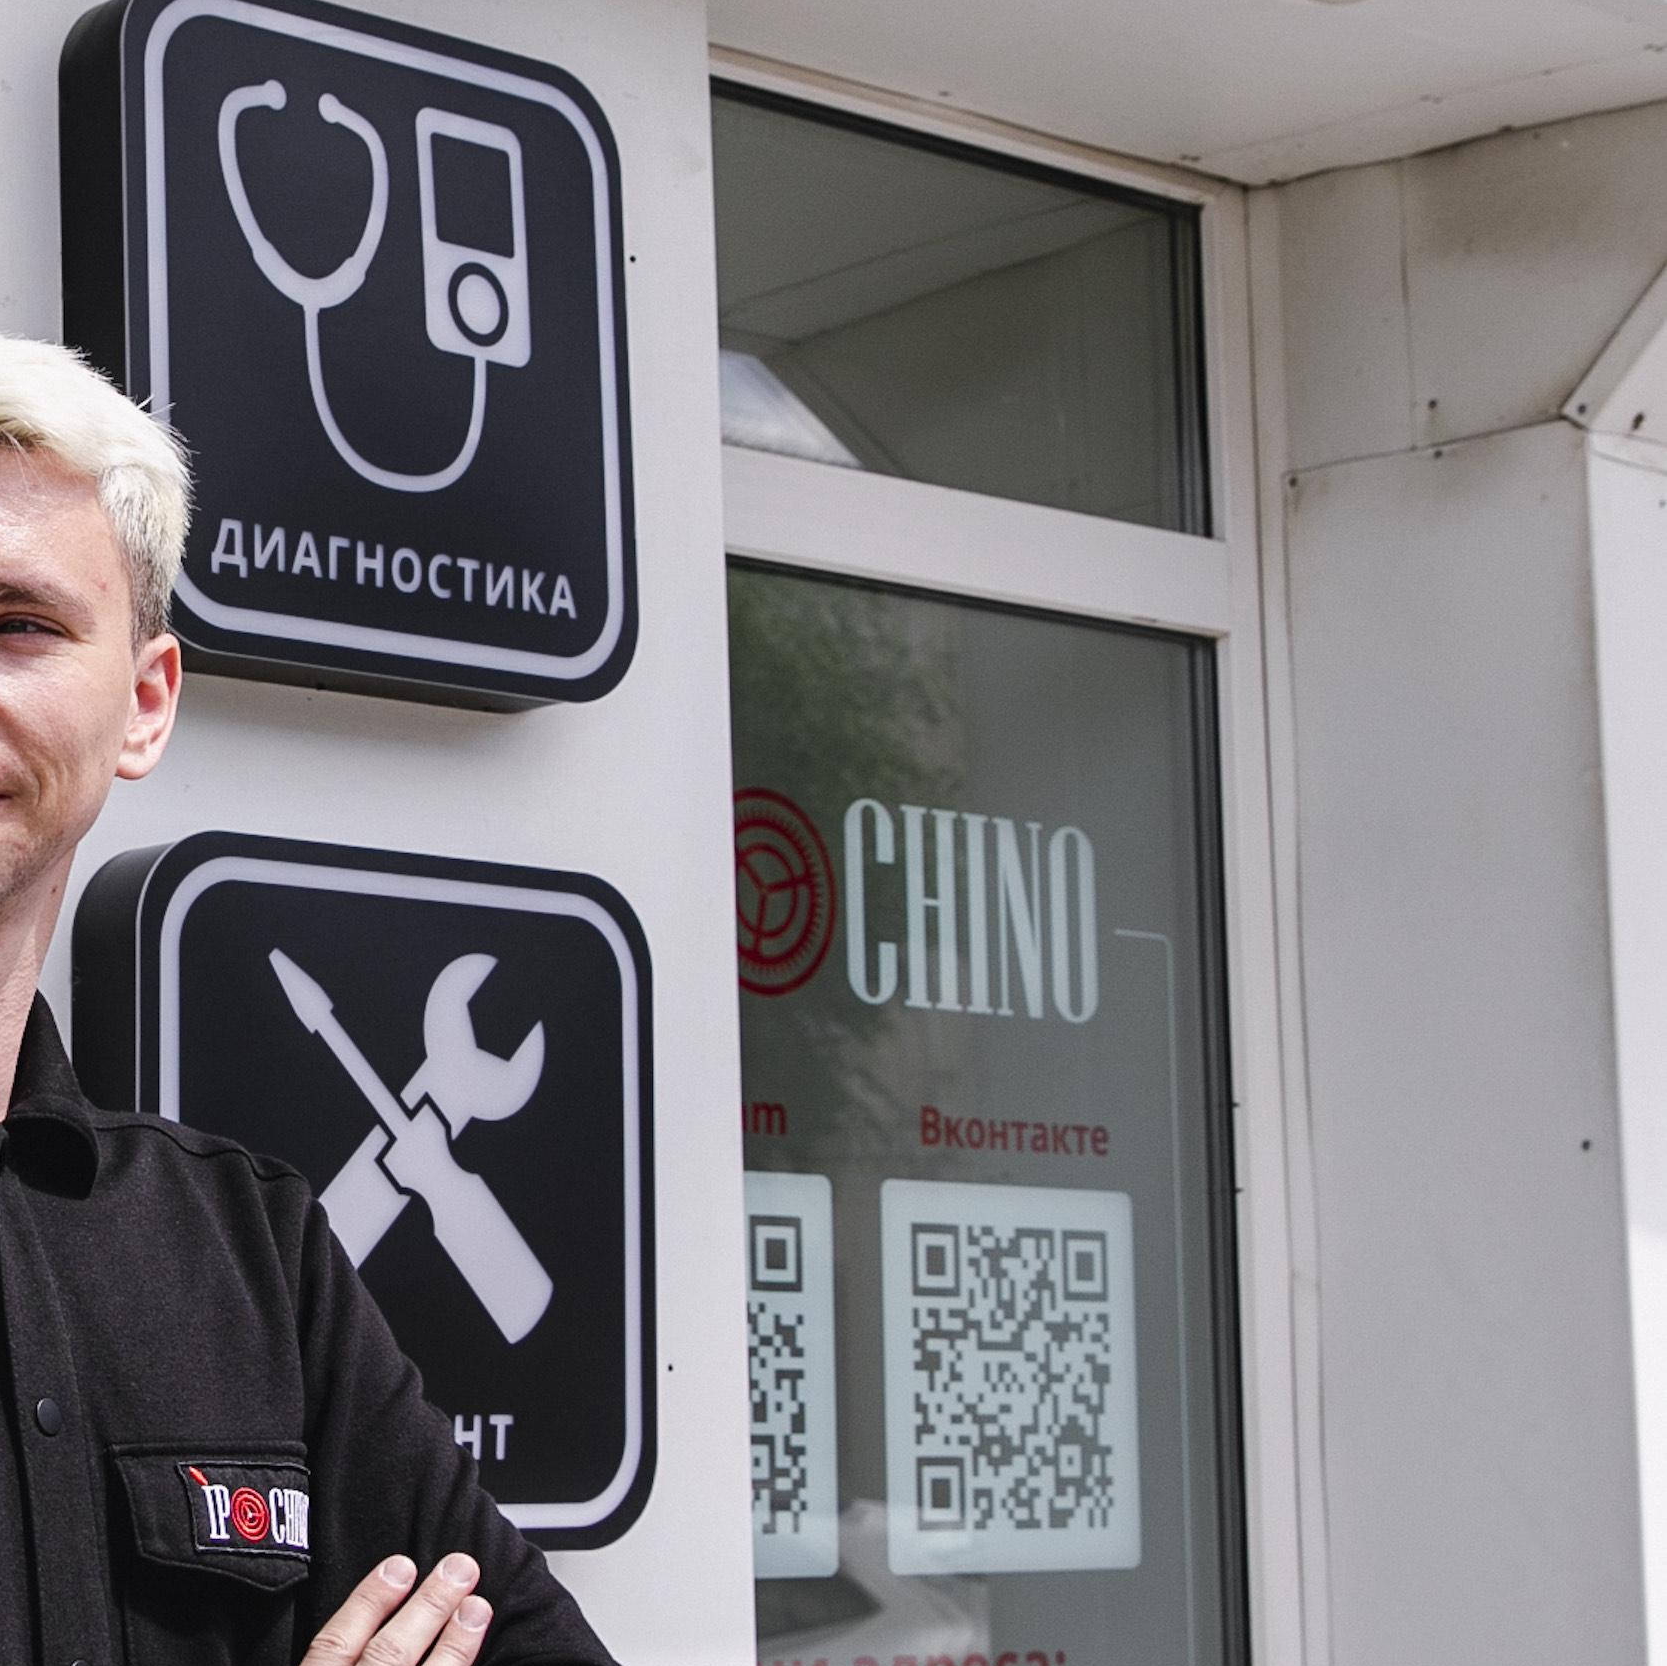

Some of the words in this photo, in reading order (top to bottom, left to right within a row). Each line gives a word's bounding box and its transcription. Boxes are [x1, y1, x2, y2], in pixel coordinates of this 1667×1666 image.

[211, 519, 577, 620] ДИАГНОСТИКА
[742, 1102, 788, 1136] m
[920, 1106, 1110, 1157] Вконтакте
